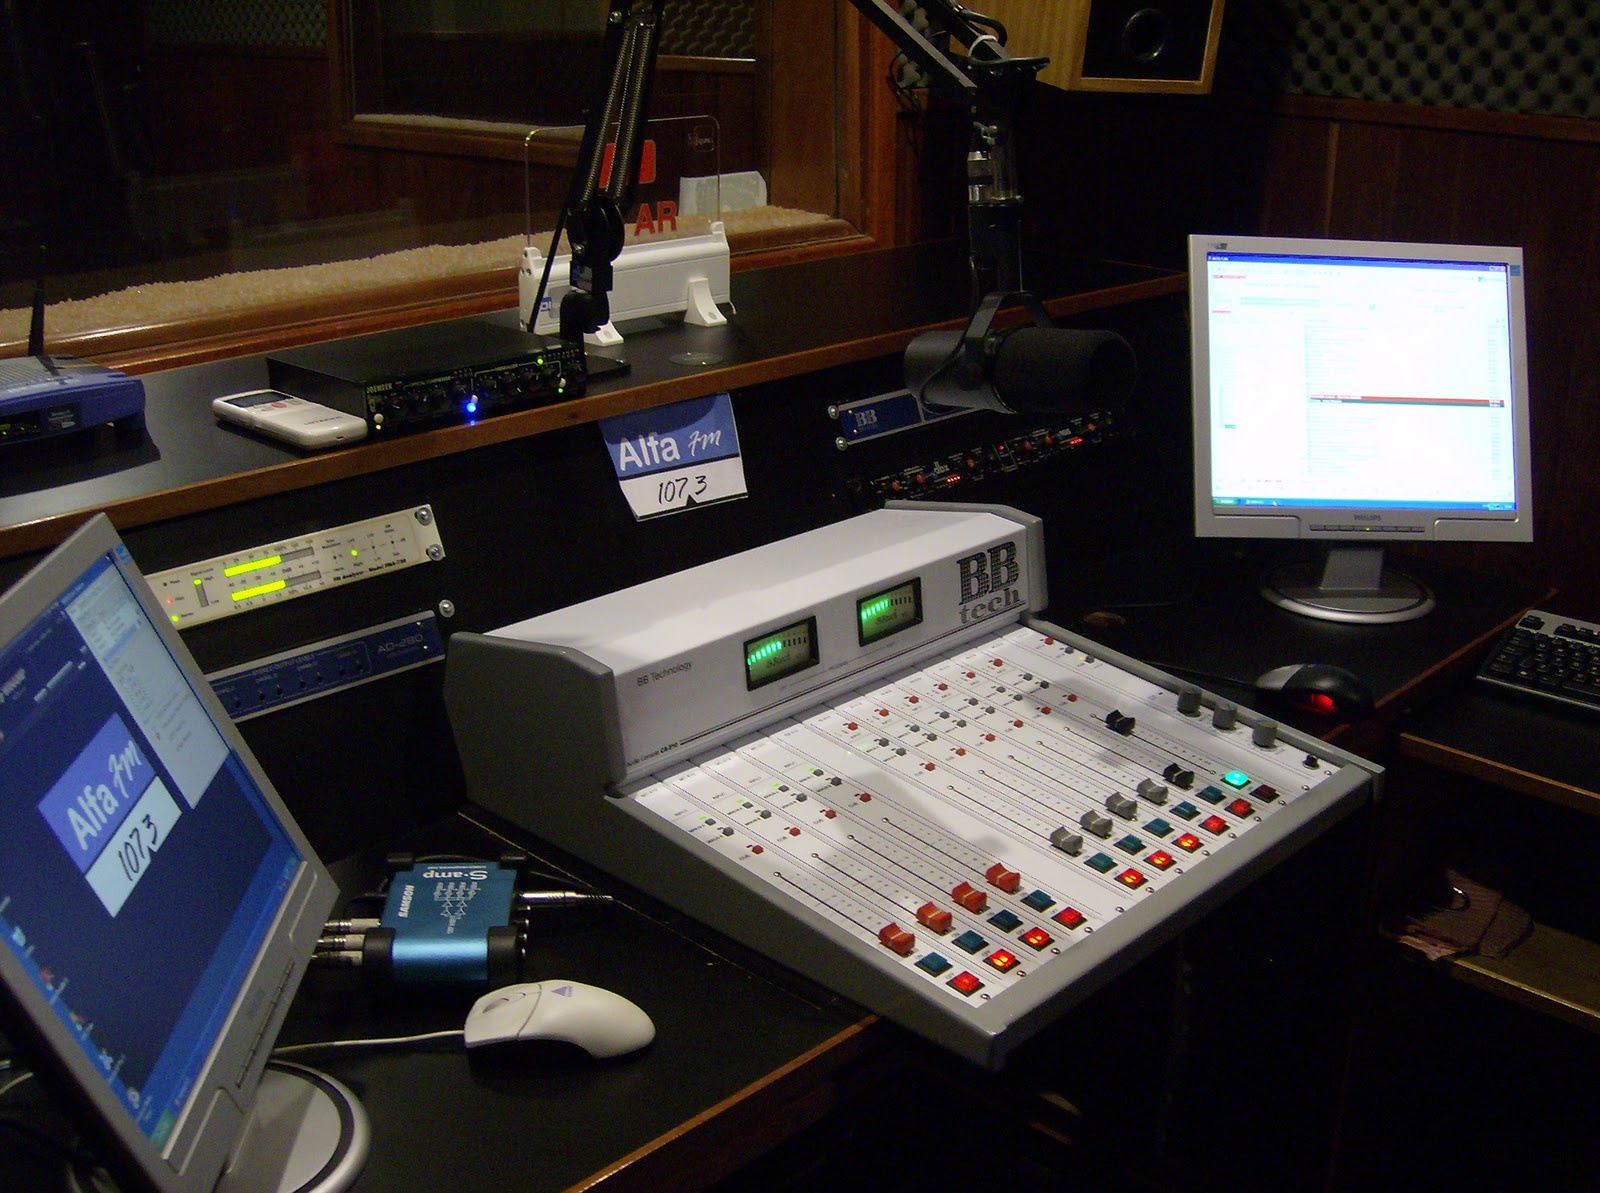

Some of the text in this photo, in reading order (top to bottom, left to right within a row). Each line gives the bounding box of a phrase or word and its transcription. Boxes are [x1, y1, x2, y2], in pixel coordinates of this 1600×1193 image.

[854, 408, 878, 428] BB
[619, 431, 681, 472] Alfa
[956, 540, 1020, 606] BB
[958, 587, 1020, 625] tech
[636, 661, 693, 687] BB Technology
[66, 782, 120, 851] Alfa
[397, 884, 415, 918] SAMSON
